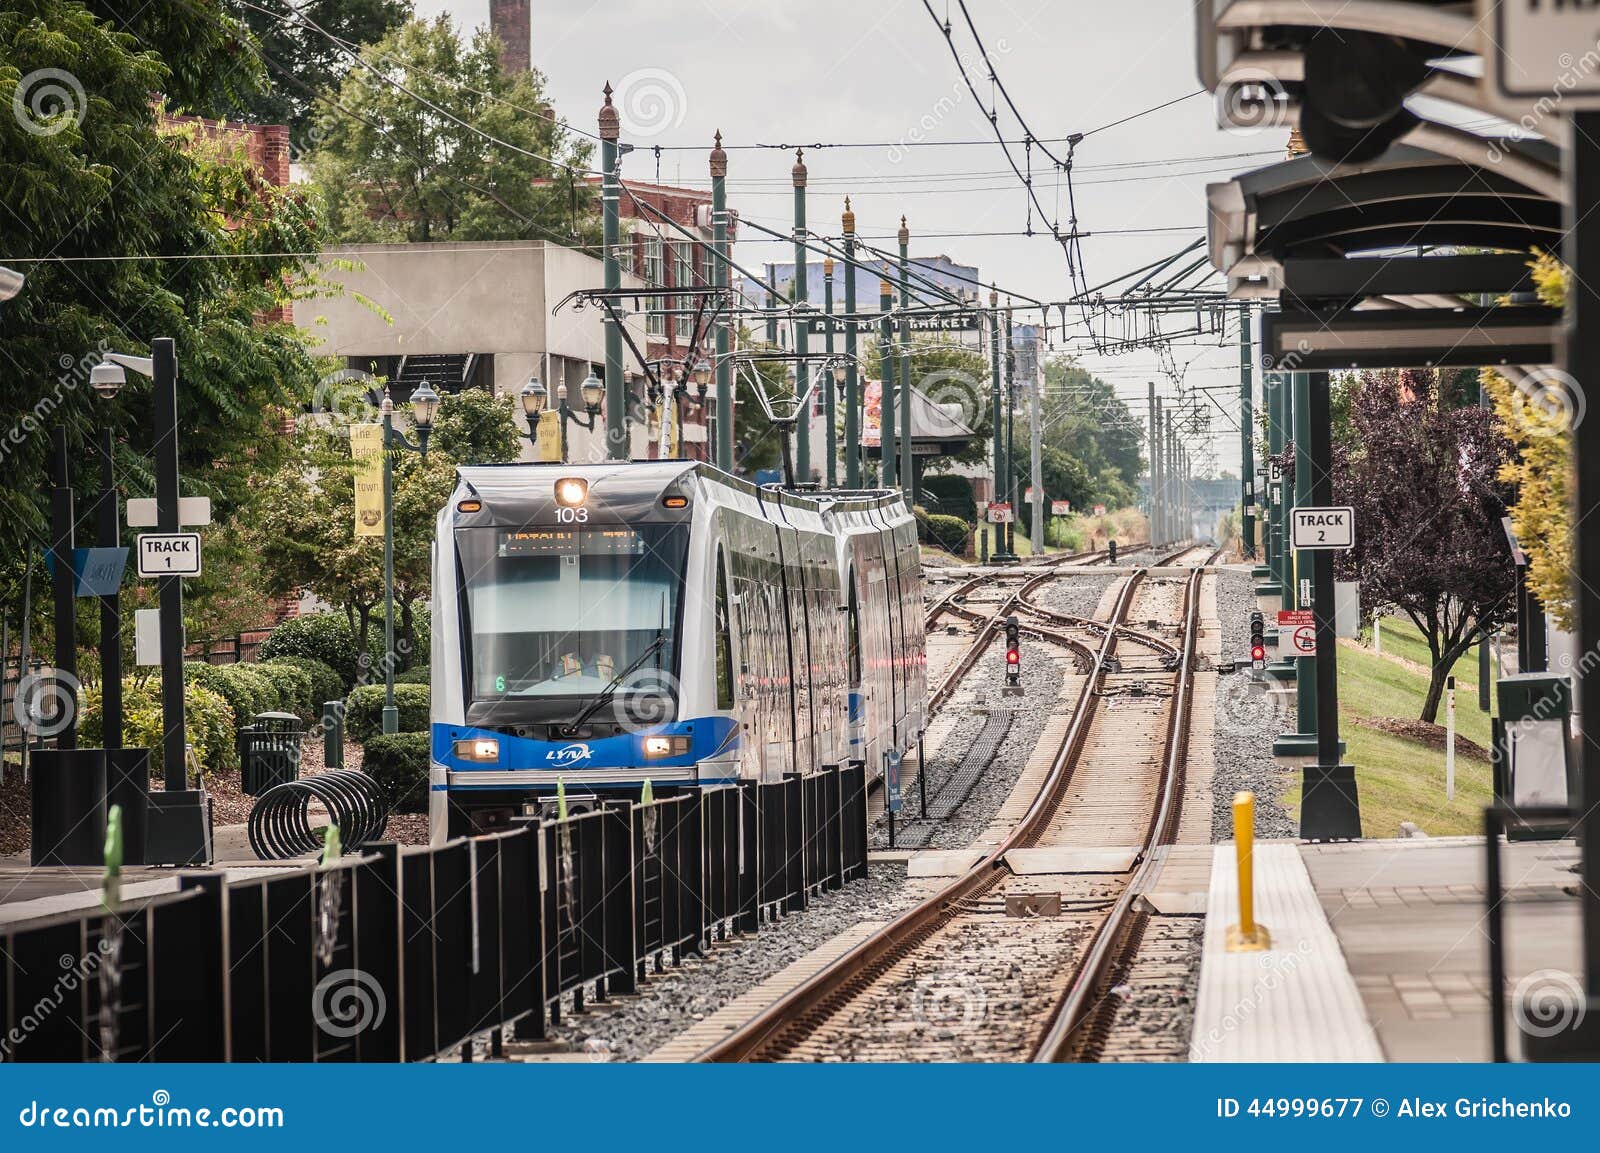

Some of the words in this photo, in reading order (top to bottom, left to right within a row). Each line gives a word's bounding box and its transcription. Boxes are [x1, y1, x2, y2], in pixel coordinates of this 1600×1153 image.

[554, 507, 589, 523] 103
[1299, 514, 1344, 526] TRACK
[1318, 530, 1325, 542] 2
[146, 541, 190, 553] TRACK
[164, 556, 171, 568] 1
[495, 675, 505, 692] 6
